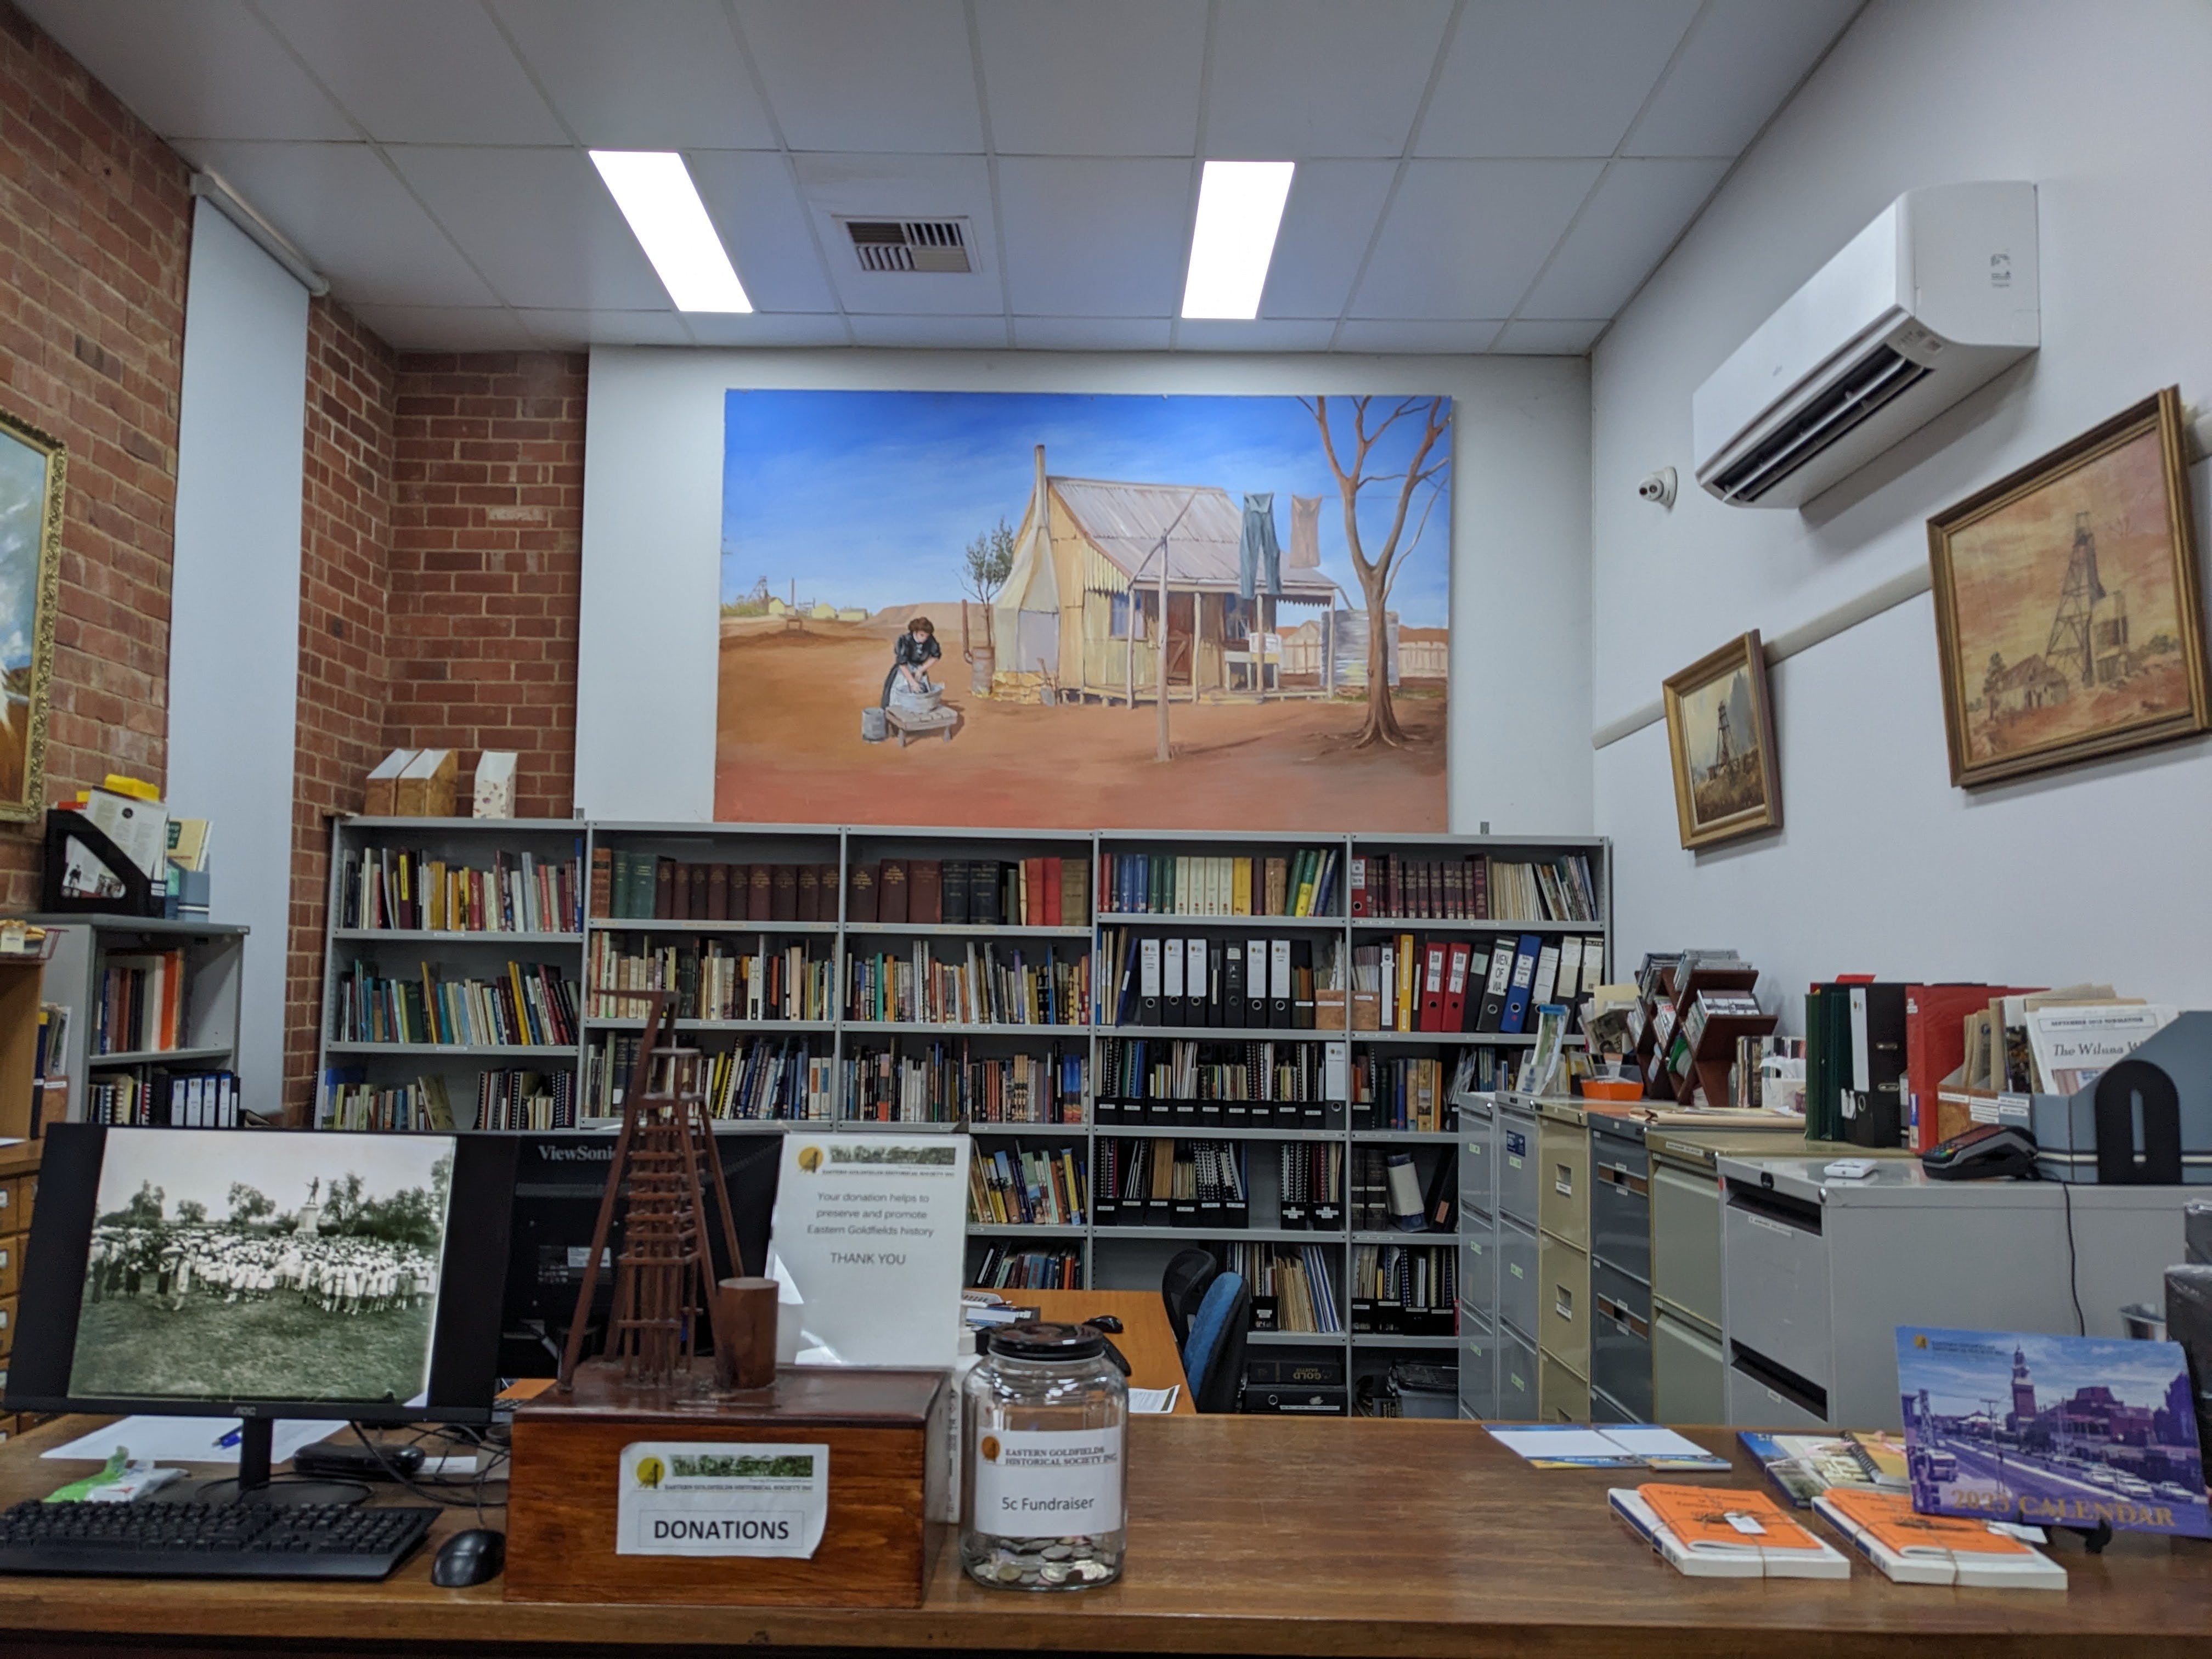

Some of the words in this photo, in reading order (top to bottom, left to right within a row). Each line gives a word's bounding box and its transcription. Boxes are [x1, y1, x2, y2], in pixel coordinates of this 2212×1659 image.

[2053, 1044, 2075, 1057] The
[2078, 1042, 2124, 1056] Wiluna
[538, 1146, 616, 1161] ViewSoni
[817, 1192, 840, 1202] Your
[843, 1193, 887, 1203] donation
[889, 1193, 917, 1204] helps
[919, 1194, 929, 1203] to
[816, 1210, 860, 1219] preserve
[862, 1209, 882, 1218] and
[884, 1210, 927, 1220] promote
[807, 1224, 845, 1235] Eastern
[848, 1225, 898, 1235] Goldfields
[900, 1226, 935, 1238] history
[831, 1252, 874, 1265] THANK
[877, 1253, 906, 1266] YOU
[1006, 1449, 1047, 1457] EASTERN
[1049, 1447, 1105, 1457] GOLDFIELDS
[1005, 1457, 1062, 1466] HISTORICAL
[1064, 1455, 1102, 1465] SOCIETY
[1002, 1497, 1018, 1510] 5c
[1022, 1497, 1095, 1511] Fundraiser
[2019, 1496, 2176, 1527] CALENDAR
[654, 1520, 789, 1539] DONATIONS
